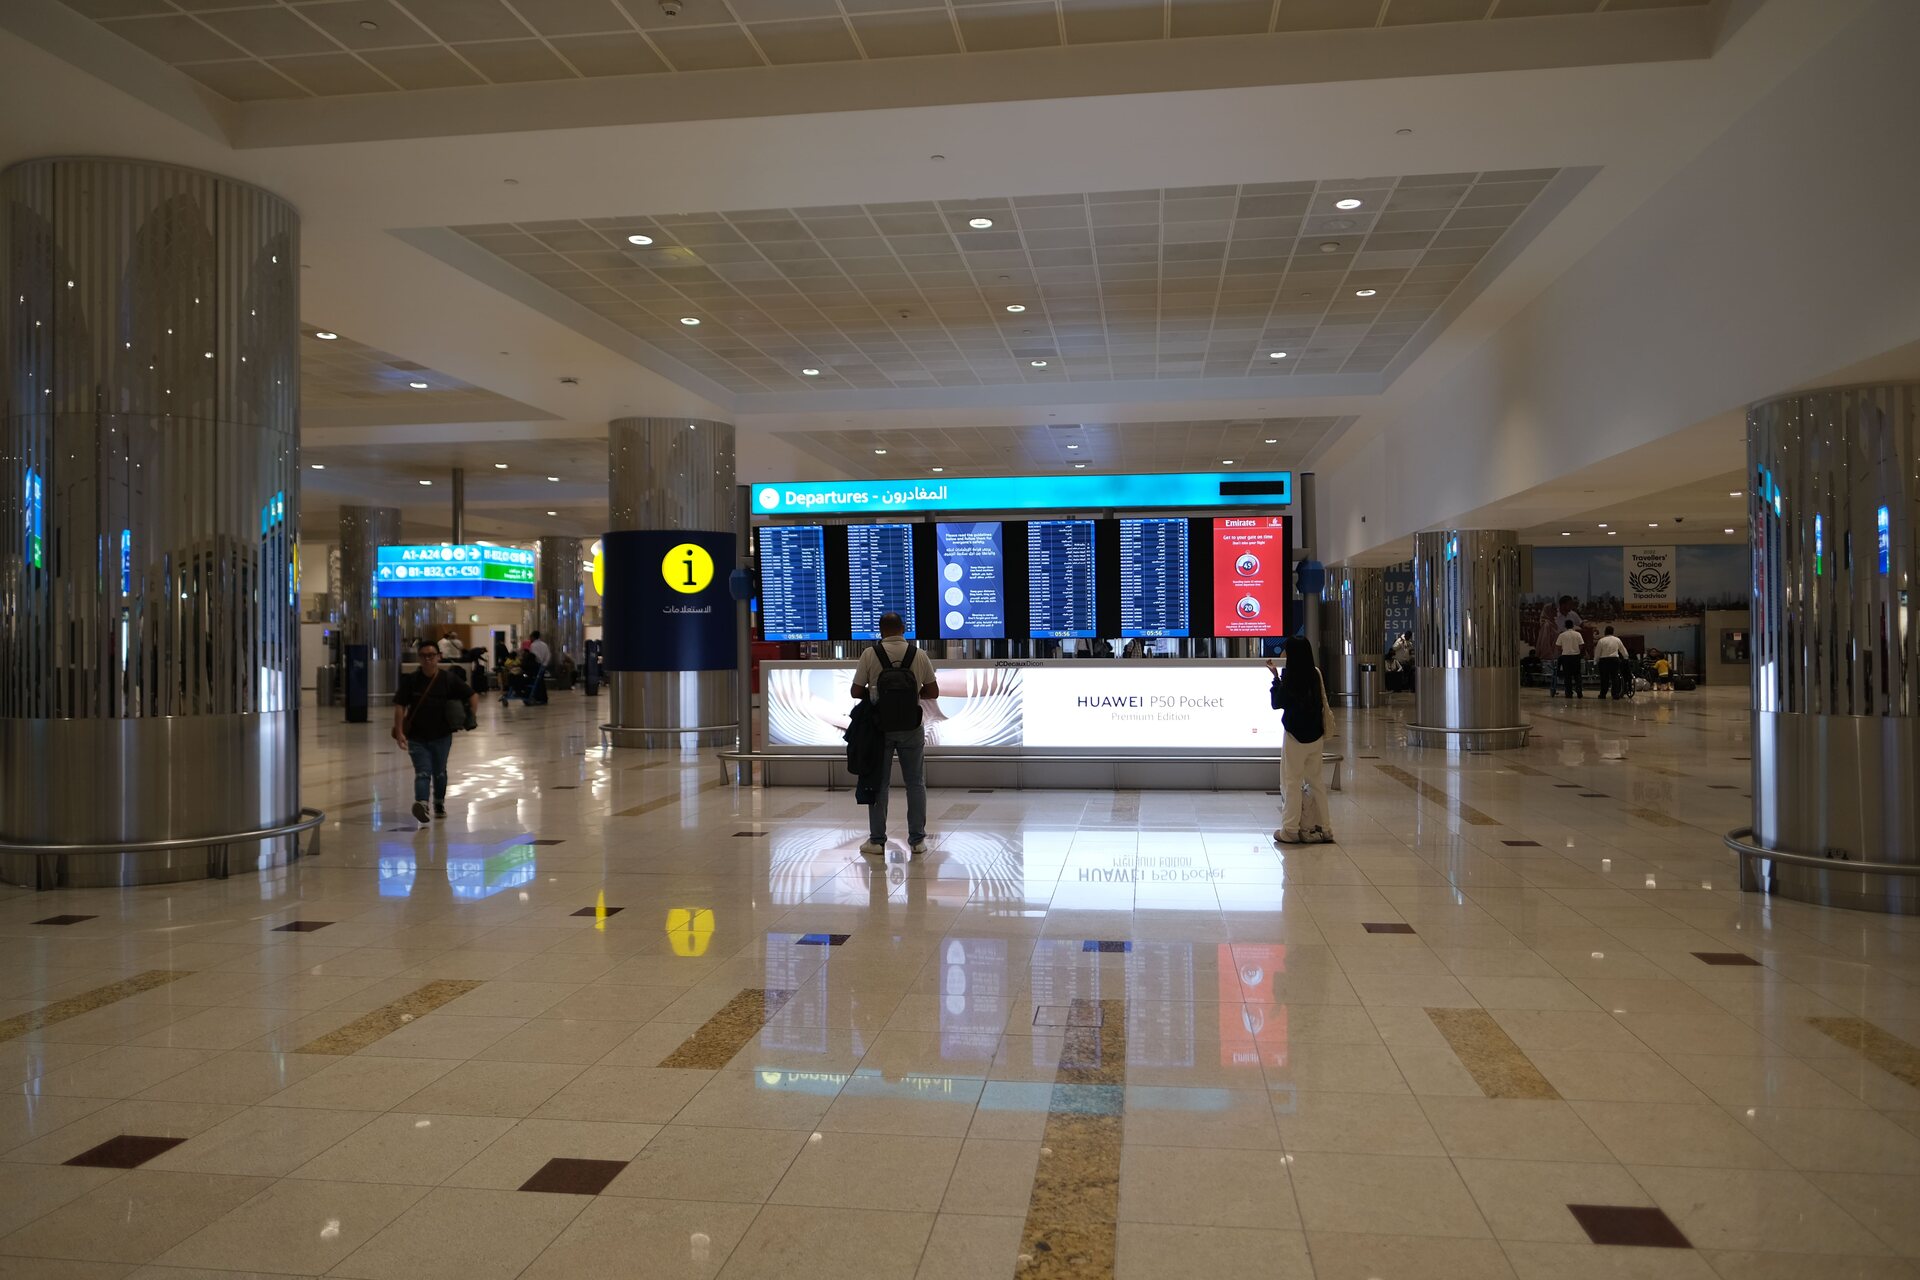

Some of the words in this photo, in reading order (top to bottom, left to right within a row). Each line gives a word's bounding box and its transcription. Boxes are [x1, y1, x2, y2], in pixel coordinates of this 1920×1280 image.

[785, 491, 869, 507] Departures
[882, 486, 947, 504] المغادرون
[1225, 519, 1256, 527] Emirates
[402, 549, 440, 560] A1-A24
[1385, 581, 1415, 592] UBA
[662, 605, 711, 613] الاستعلامات
[1385, 608, 1409, 617] OST
[1385, 620, 1412, 629] ESTI
[1077, 696, 1143, 707] HUAWEI
[1150, 696, 1175, 707] P50
[1180, 695, 1224, 708] Pocket
[1111, 712, 1153, 721] Premium
[1158, 712, 1190, 721] Edition
